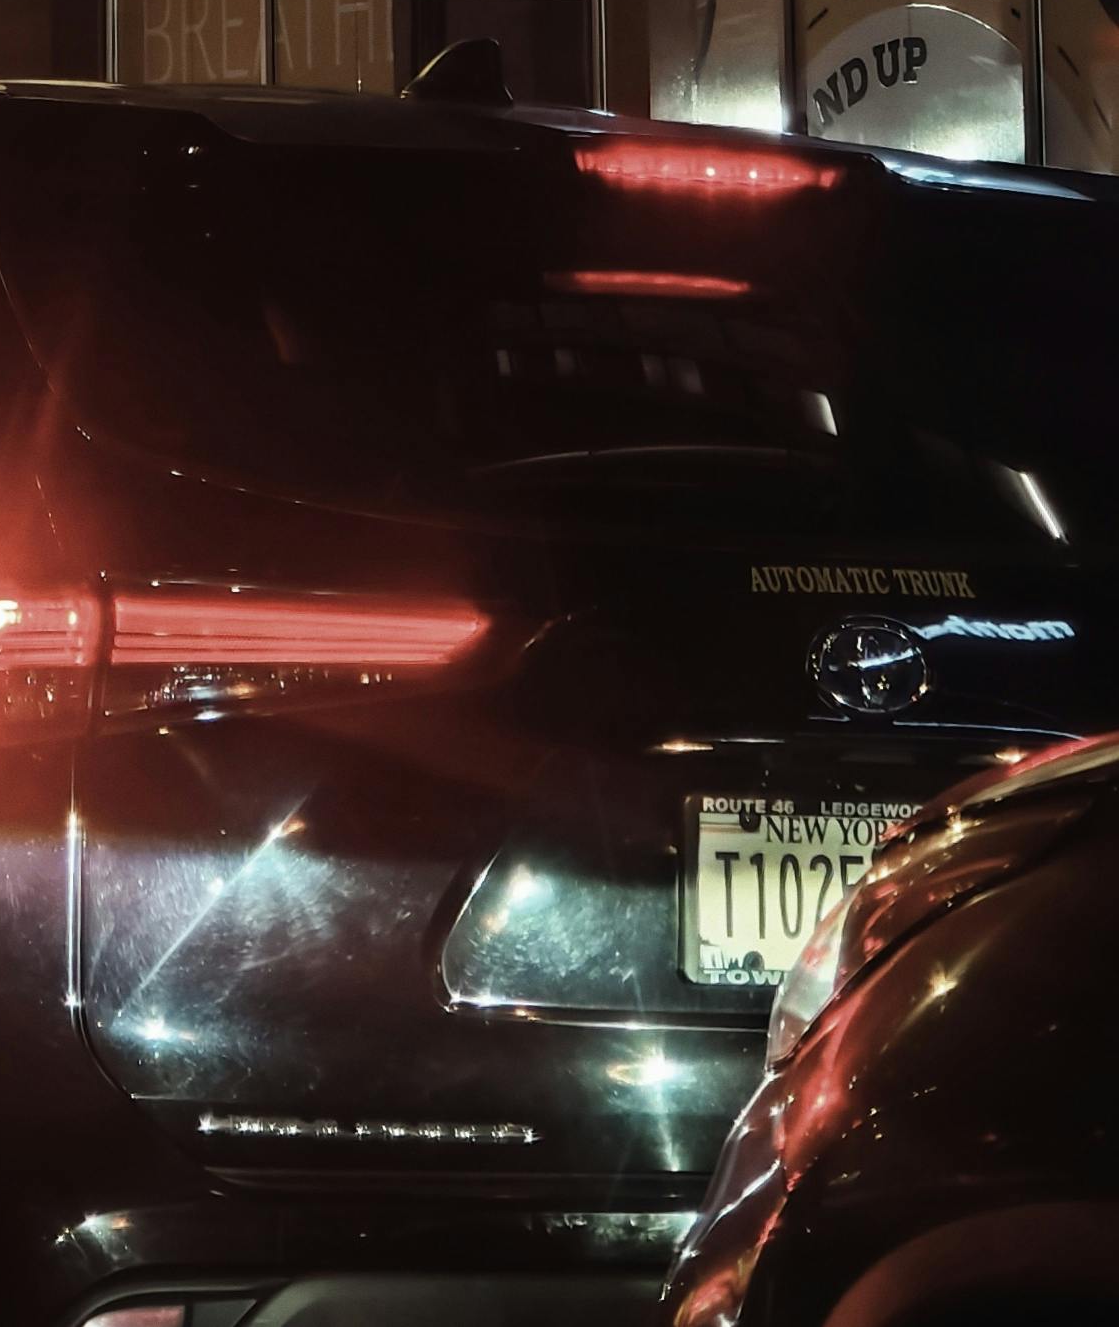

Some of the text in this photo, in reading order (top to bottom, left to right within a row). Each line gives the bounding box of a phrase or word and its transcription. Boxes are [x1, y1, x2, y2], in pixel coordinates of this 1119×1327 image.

[873, 37, 927, 88] UP
[751, 566, 976, 598] AUTOMATIC TRUNK
[703, 798, 766, 814] ROUTE
[771, 799, 795, 814] 46
[765, 816, 906, 847] NEW YOR
[703, 968, 786, 986] TOW
